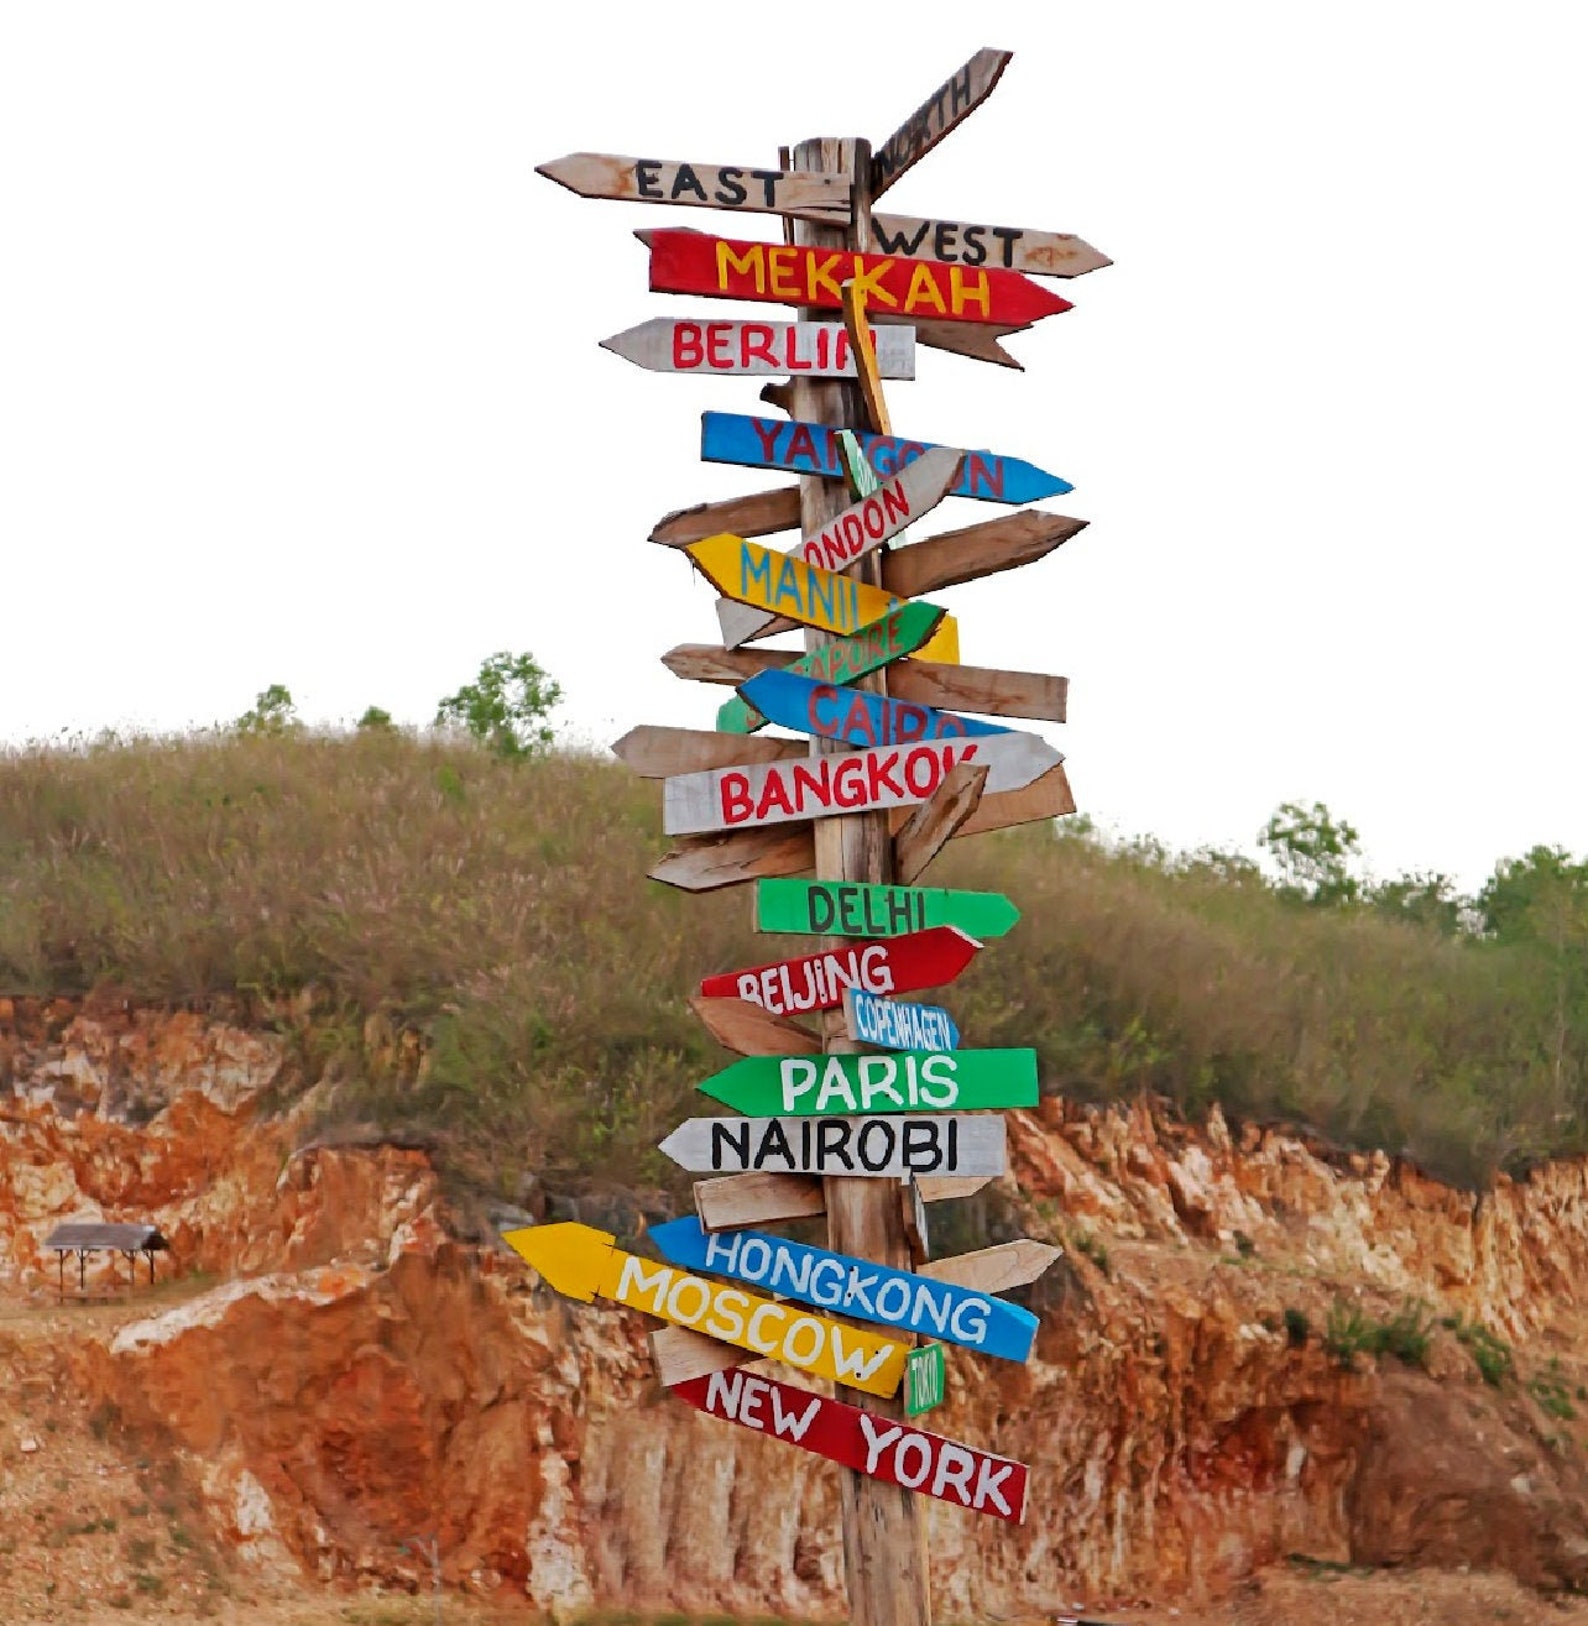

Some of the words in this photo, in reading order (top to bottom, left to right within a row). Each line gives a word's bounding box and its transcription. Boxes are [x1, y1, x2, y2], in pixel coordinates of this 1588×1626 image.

[874, 63, 970, 174] NORTH
[635, 160, 783, 208] EAST
[716, 241, 991, 317] MEKKAH
[872, 217, 1024, 269] WEST
[752, 416, 1004, 498] YAGN
[803, 478, 910, 570] ONDON
[740, 542, 898, 630] MANI
[807, 886, 926, 934] DELHI
[737, 945, 895, 1015] BEIJING
[855, 994, 951, 1051] COPENHAGEN
[779, 1055, 960, 1112] PARIS
[711, 1119, 958, 1173] NAIROBI
[616, 1256, 893, 1383] MOSCOW
[705, 1231, 991, 1344] HONGKONG
[706, 1371, 821, 1442] NEW
[859, 1413, 1012, 1515] YORK
